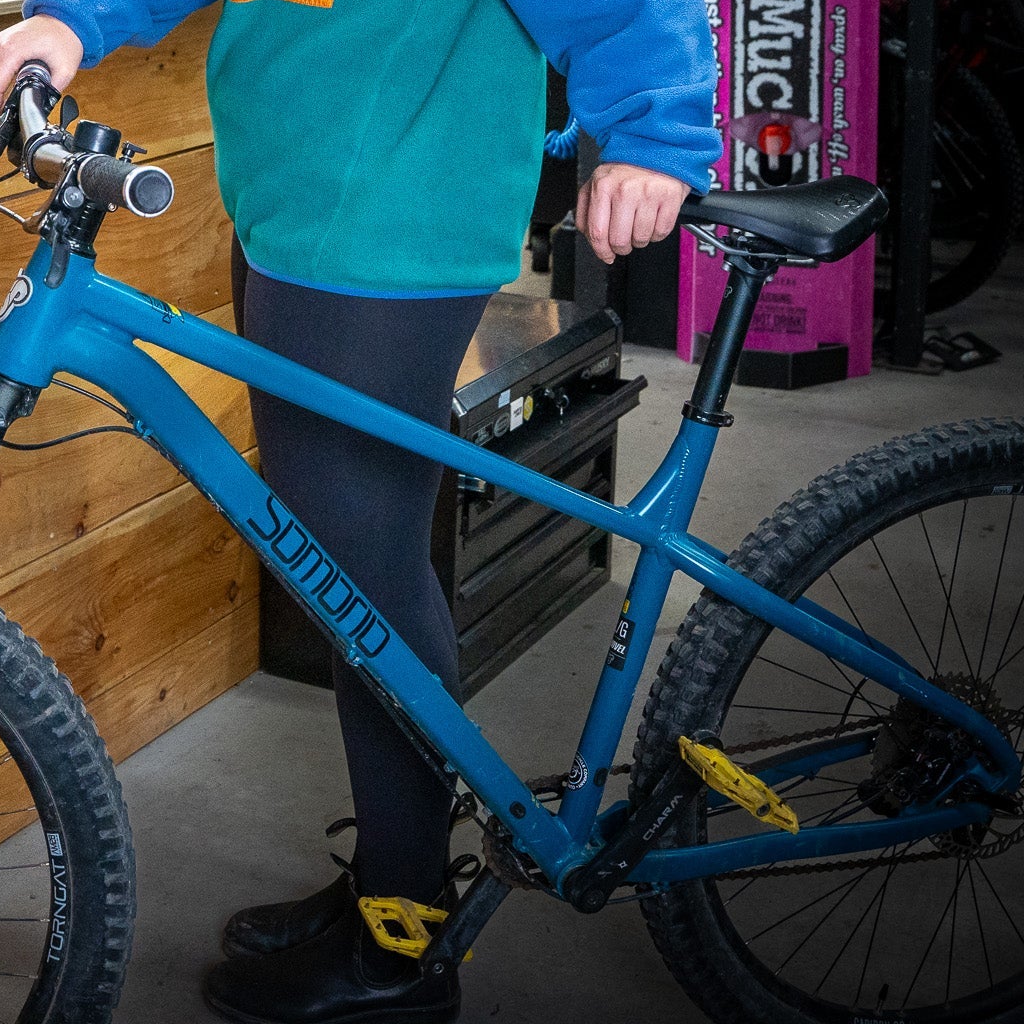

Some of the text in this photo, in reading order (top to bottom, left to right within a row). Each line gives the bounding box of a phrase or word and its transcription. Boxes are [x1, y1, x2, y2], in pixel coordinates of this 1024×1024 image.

[830, 6, 847, 55] spray
[833, 87, 850, 129] wash
[642, 792, 683, 842] CHARM
[46, 858, 67, 963] TORNGAT
